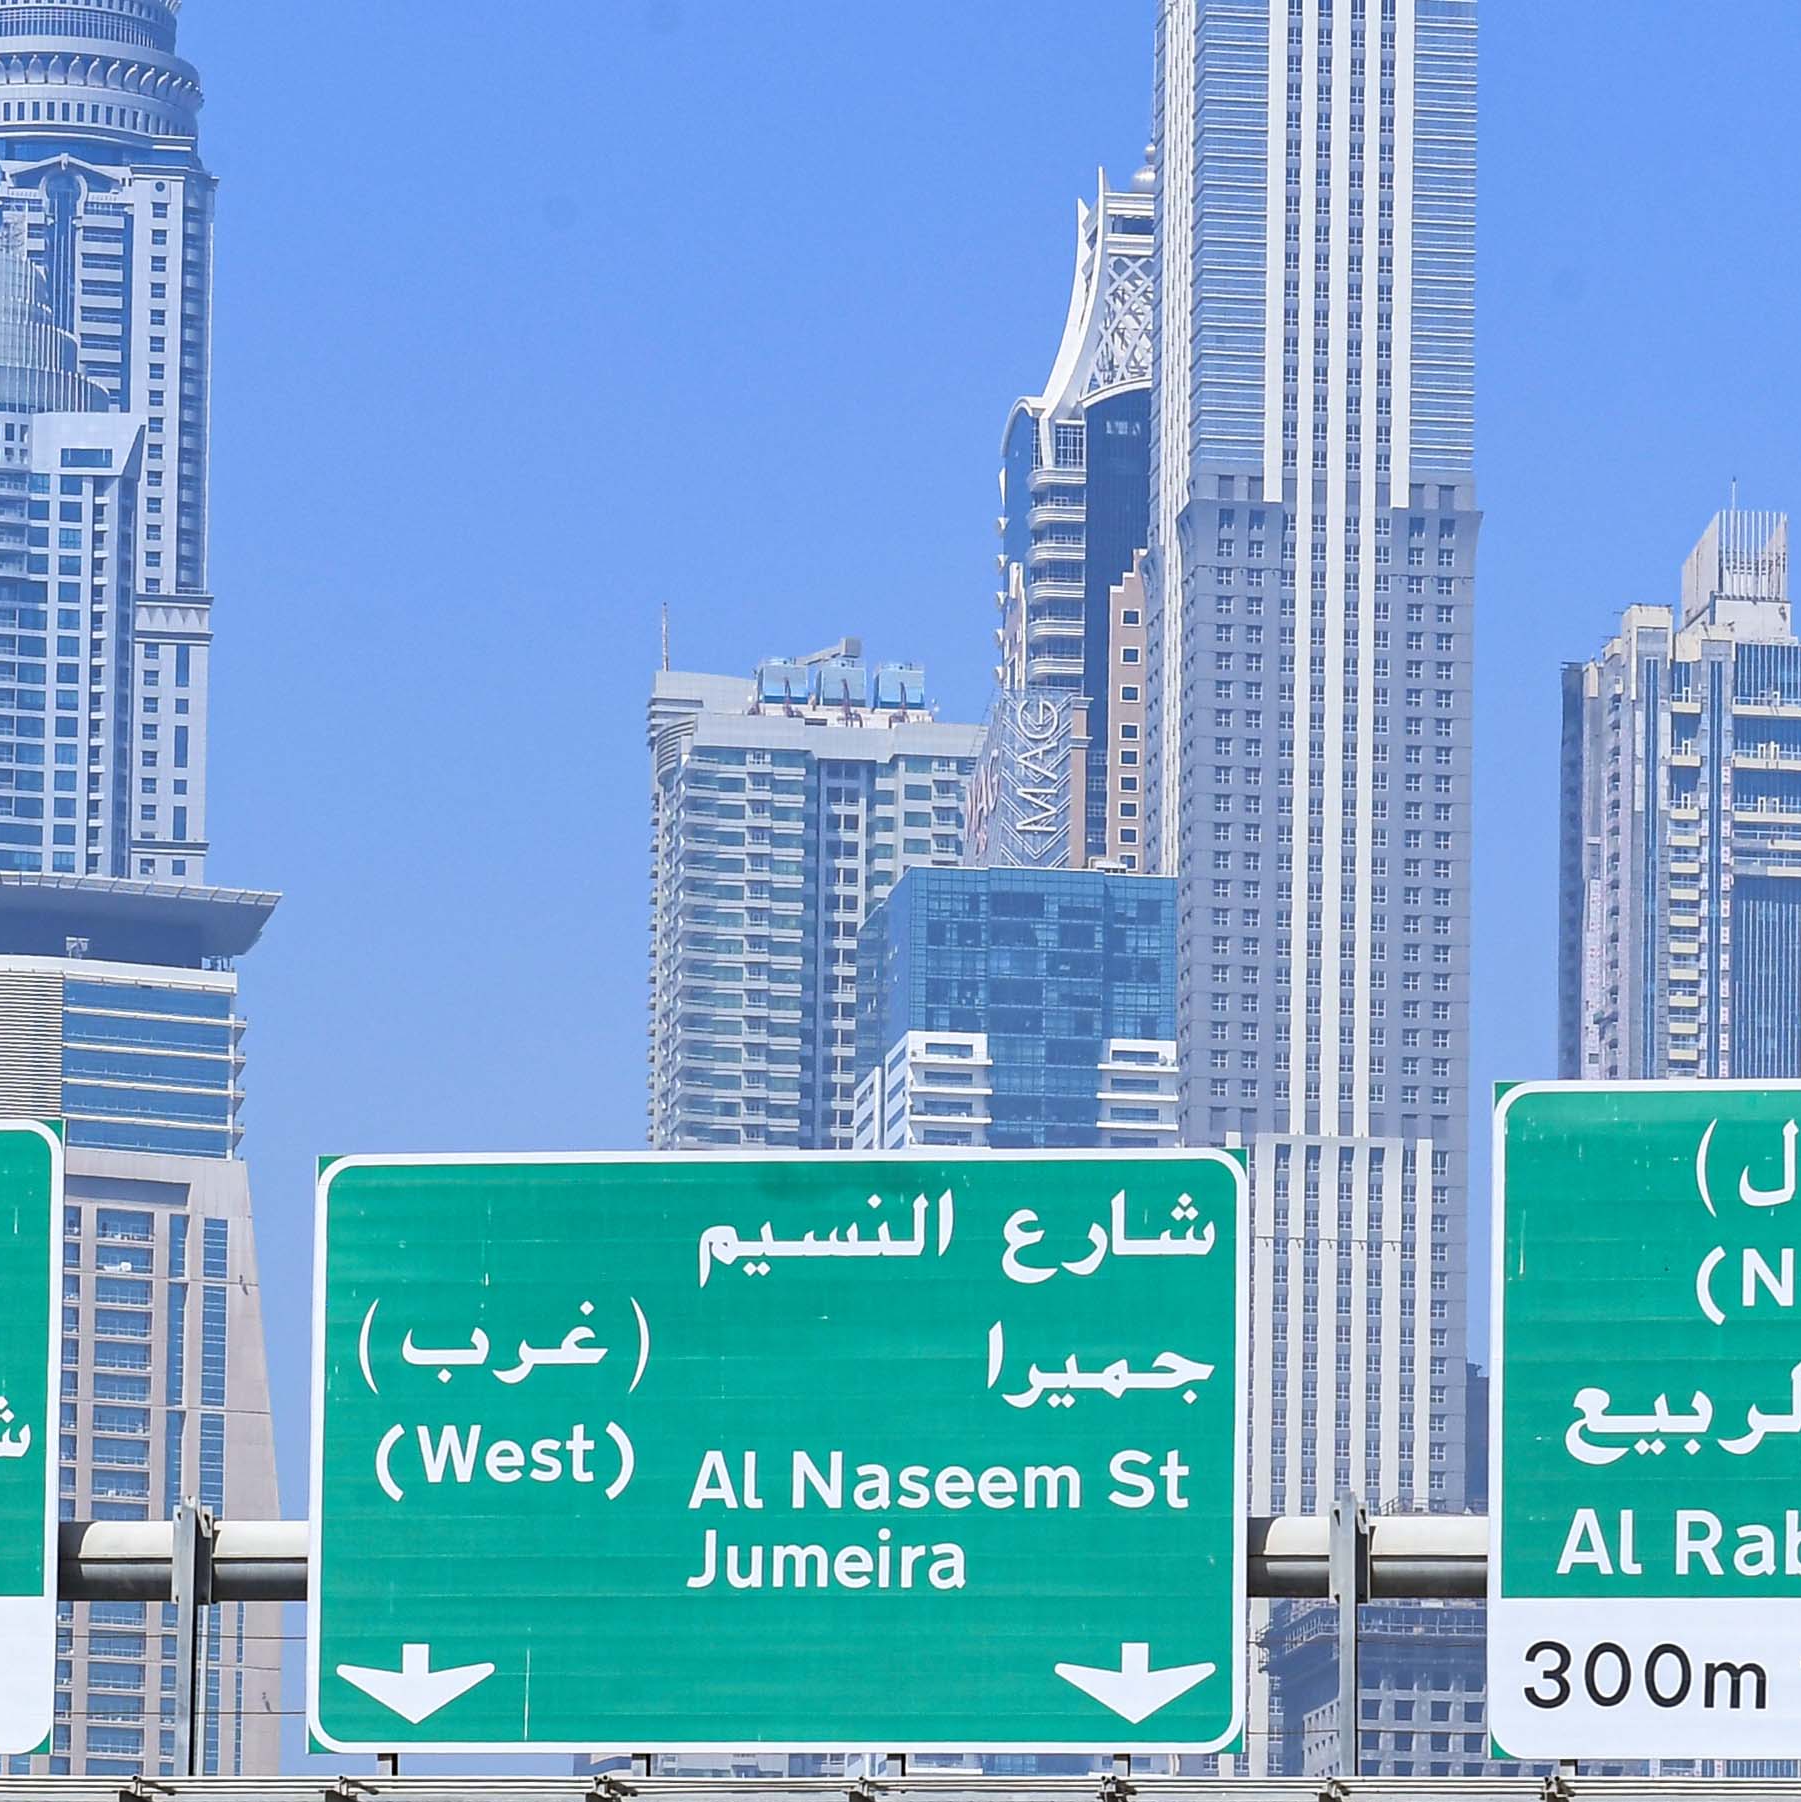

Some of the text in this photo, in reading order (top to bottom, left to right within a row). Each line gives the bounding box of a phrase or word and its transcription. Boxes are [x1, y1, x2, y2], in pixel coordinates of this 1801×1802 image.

[1016, 698, 1059, 832] MAG
[700, 1189, 1215, 1287] شارع النسيم
[359, 1299, 650, 1393] (غرب)
[987, 1321, 1215, 1408] جميرا
[375, 1421, 635, 1502] (West)
[689, 1449, 1190, 1511] Al Naseem St
[687, 1528, 966, 1590] Jumeira
[1557, 1509, 1642, 1574] Al
[1524, 1640, 1767, 1709] 300m
